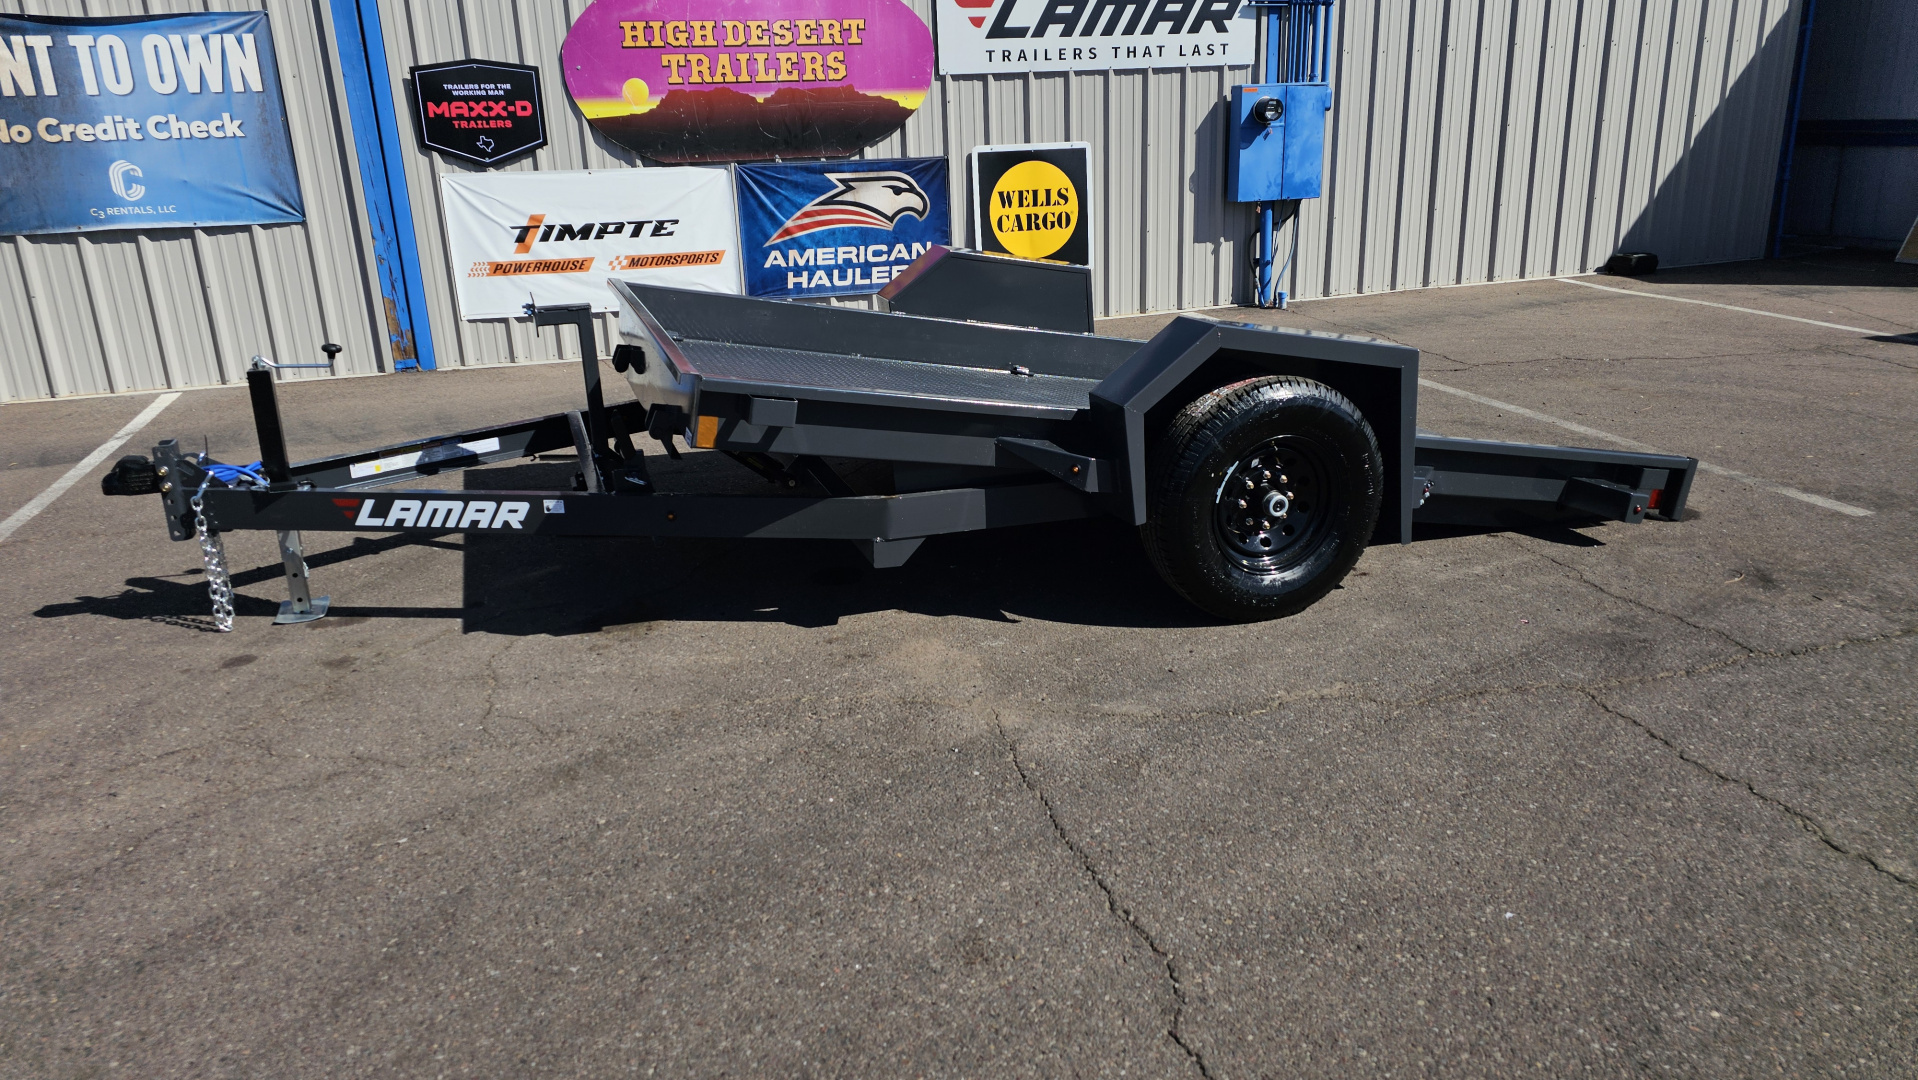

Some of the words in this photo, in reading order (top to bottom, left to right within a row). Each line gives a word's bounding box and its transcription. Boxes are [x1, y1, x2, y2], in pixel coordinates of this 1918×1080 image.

[984, 0, 1242, 39] LAMAR
[619, 20, 718, 48] HIGH
[722, 18, 866, 47] DESERT
[67, 34, 135, 96] TO
[141, 33, 264, 95] OWN
[985, 47, 1098, 63] TRAILERS
[1111, 44, 1166, 59] THAT
[1178, 42, 1230, 57] LAST
[660, 50, 848, 84] TRAILERS
[427, 101, 532, 117] MAXX-D
[37, 115, 144, 143] Credit
[147, 113, 245, 140] Check
[452, 119, 513, 129] TRAILERS
[106, 206, 157, 216] RENTALS,
[157, 204, 177, 214] LLC
[996, 187, 1070, 209] WELLS
[509, 213, 680, 255] TIMPTE
[996, 211, 1072, 233] CARGO
[492, 259, 589, 275] POWERHOUSE
[628, 252, 720, 268] MOTORSPORTS
[763, 241, 932, 269] AMERICAN
[354, 498, 531, 530] LAMAR
